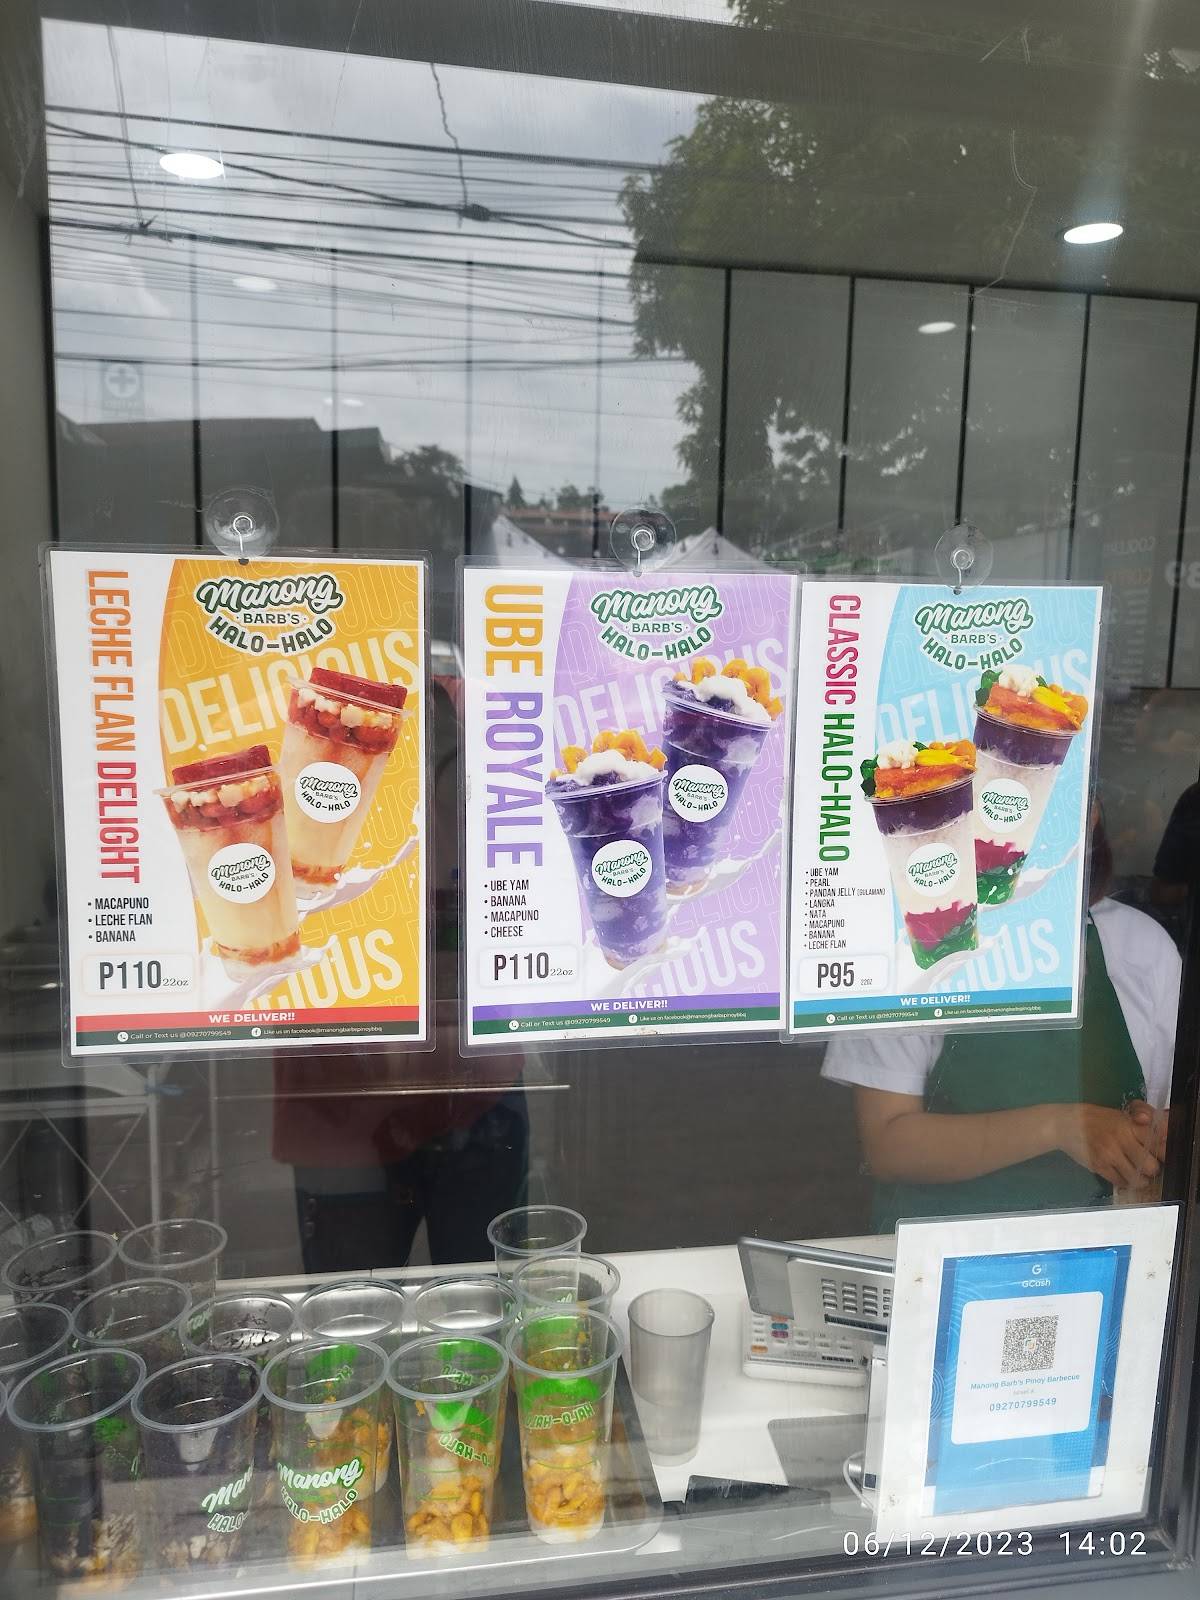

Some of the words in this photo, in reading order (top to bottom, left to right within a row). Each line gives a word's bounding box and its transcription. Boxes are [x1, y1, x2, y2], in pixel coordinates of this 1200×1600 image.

[196, 574, 344, 614] Manong
[591, 585, 722, 623] Manong
[88, 570, 133, 667] LECHE
[243, 613, 301, 625] BARB'S
[915, 598, 1034, 636] Manong
[209, 616, 333, 653] HALO-HALO
[485, 585, 544, 677] UBE
[632, 622, 683, 633] BARB'S
[601, 626, 712, 661] HALO-HALO
[951, 634, 997, 644] BARB'S
[824, 595, 861, 705] CLASSIC
[923, 637, 1023, 670] HALO-HALO
[94, 676, 136, 751] FLAN
[300, 777, 358, 798] Manong
[485, 692, 544, 868] ROYALE
[673, 778, 725, 799] Manong
[818, 714, 855, 862] HALO-HALO
[301, 790, 351, 811] HALO-HALO
[674, 792, 718, 811] HALO-HALO
[982, 792, 1029, 811] Manong
[97, 762, 140, 883] DELIGHT
[983, 805, 1022, 823] HALO-HALO
[211, 855, 271, 880] Manong
[595, 851, 648, 875] Manong
[810, 868, 823, 877] UBE
[824, 867, 839, 876] YAM
[908, 853, 958, 876] Manong
[219, 872, 269, 892] HALO-HALO
[490, 880, 507, 891] UBE
[510, 879, 529, 890] YAM
[601, 867, 646, 887] HALO-HALO
[810, 879, 831, 887] PEARL
[914, 869, 956, 888] HALO-HALO
[490, 895, 527, 907] BANANA
[809, 888, 836, 897] PANDAN
[837, 888, 856, 896] JELLY
[95, 897, 149, 910] MACAPUNO
[809, 899, 835, 908] LANGKA
[95, 914, 126, 926] LECHE
[128, 913, 153, 925] FLAN
[490, 910, 539, 922] MACAPUNO
[809, 909, 827, 918] NATA
[490, 926, 524, 937] CHEESE
[809, 919, 845, 928] MACAPUNO
[96, 930, 136, 942] BANANA
[808, 930, 835, 939] BANANA
[808, 940, 828, 949] LECHE
[830, 940, 847, 948] FLAN
[100, 960, 162, 989] P110
[162, 978, 189, 987] 22oz
[494, 952, 549, 980] P110
[550, 968, 573, 976] 22oz
[818, 962, 855, 988] P95
[591, 1002, 609, 1011] WE
[613, 1000, 668, 1010] DELIVER!!
[900, 997, 917, 1006] WE
[921, 995, 971, 1005] DELIVER!!
[208, 1014, 230, 1023] WE
[234, 1012, 295, 1023] DELIVER!!
[1022, 1279, 1051, 1288] GCash
[971, 1378, 999, 1390] Manong
[1001, 1378, 1024, 1388] Barb's
[1025, 1377, 1046, 1386] Pinoy
[1048, 1373, 1080, 1384] Barbecue
[989, 1398, 1057, 1412] 09270799549
[276, 1456, 364, 1489] Manong
